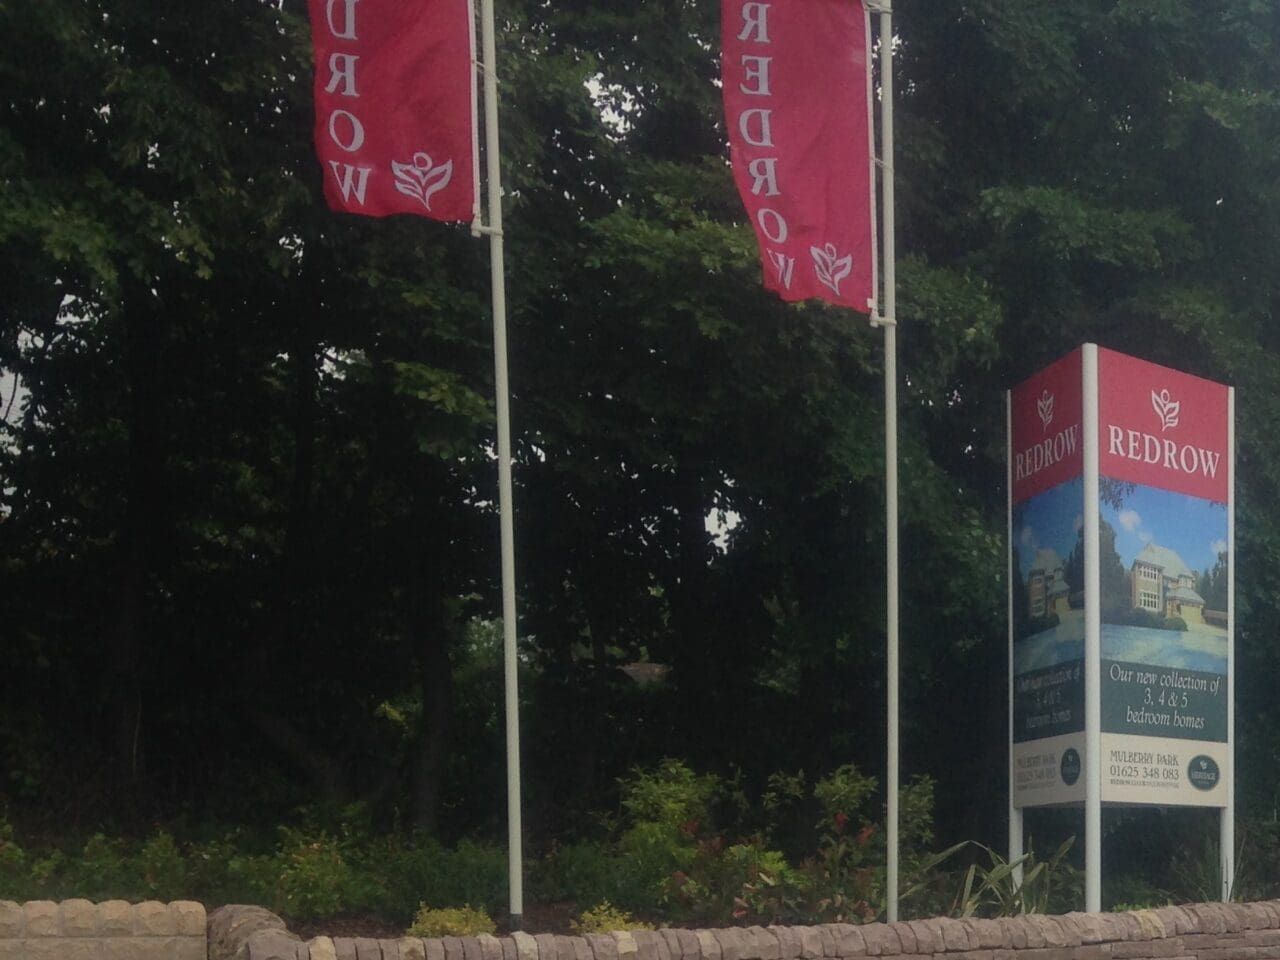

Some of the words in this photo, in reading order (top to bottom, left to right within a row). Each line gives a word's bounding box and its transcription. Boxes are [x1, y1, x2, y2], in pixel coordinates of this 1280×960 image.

[1015, 424, 1080, 480] REDROW
[1108, 424, 1221, 479] REDROW
[1110, 663, 1134, 682] Our
[1137, 671, 1157, 685] new
[1160, 672, 1207, 691] collection
[1210, 676, 1221, 696] of
[1159, 690, 1165, 706] 4
[1168, 692, 1178, 707] &
[1181, 692, 1188, 708] 5
[1126, 705, 1170, 726] bedroom
[1173, 710, 1205, 729] homes
[1110, 750, 1153, 764] MULBERRY
[1156, 753, 1179, 766] PARK
[1110, 765, 1139, 777] 01625
